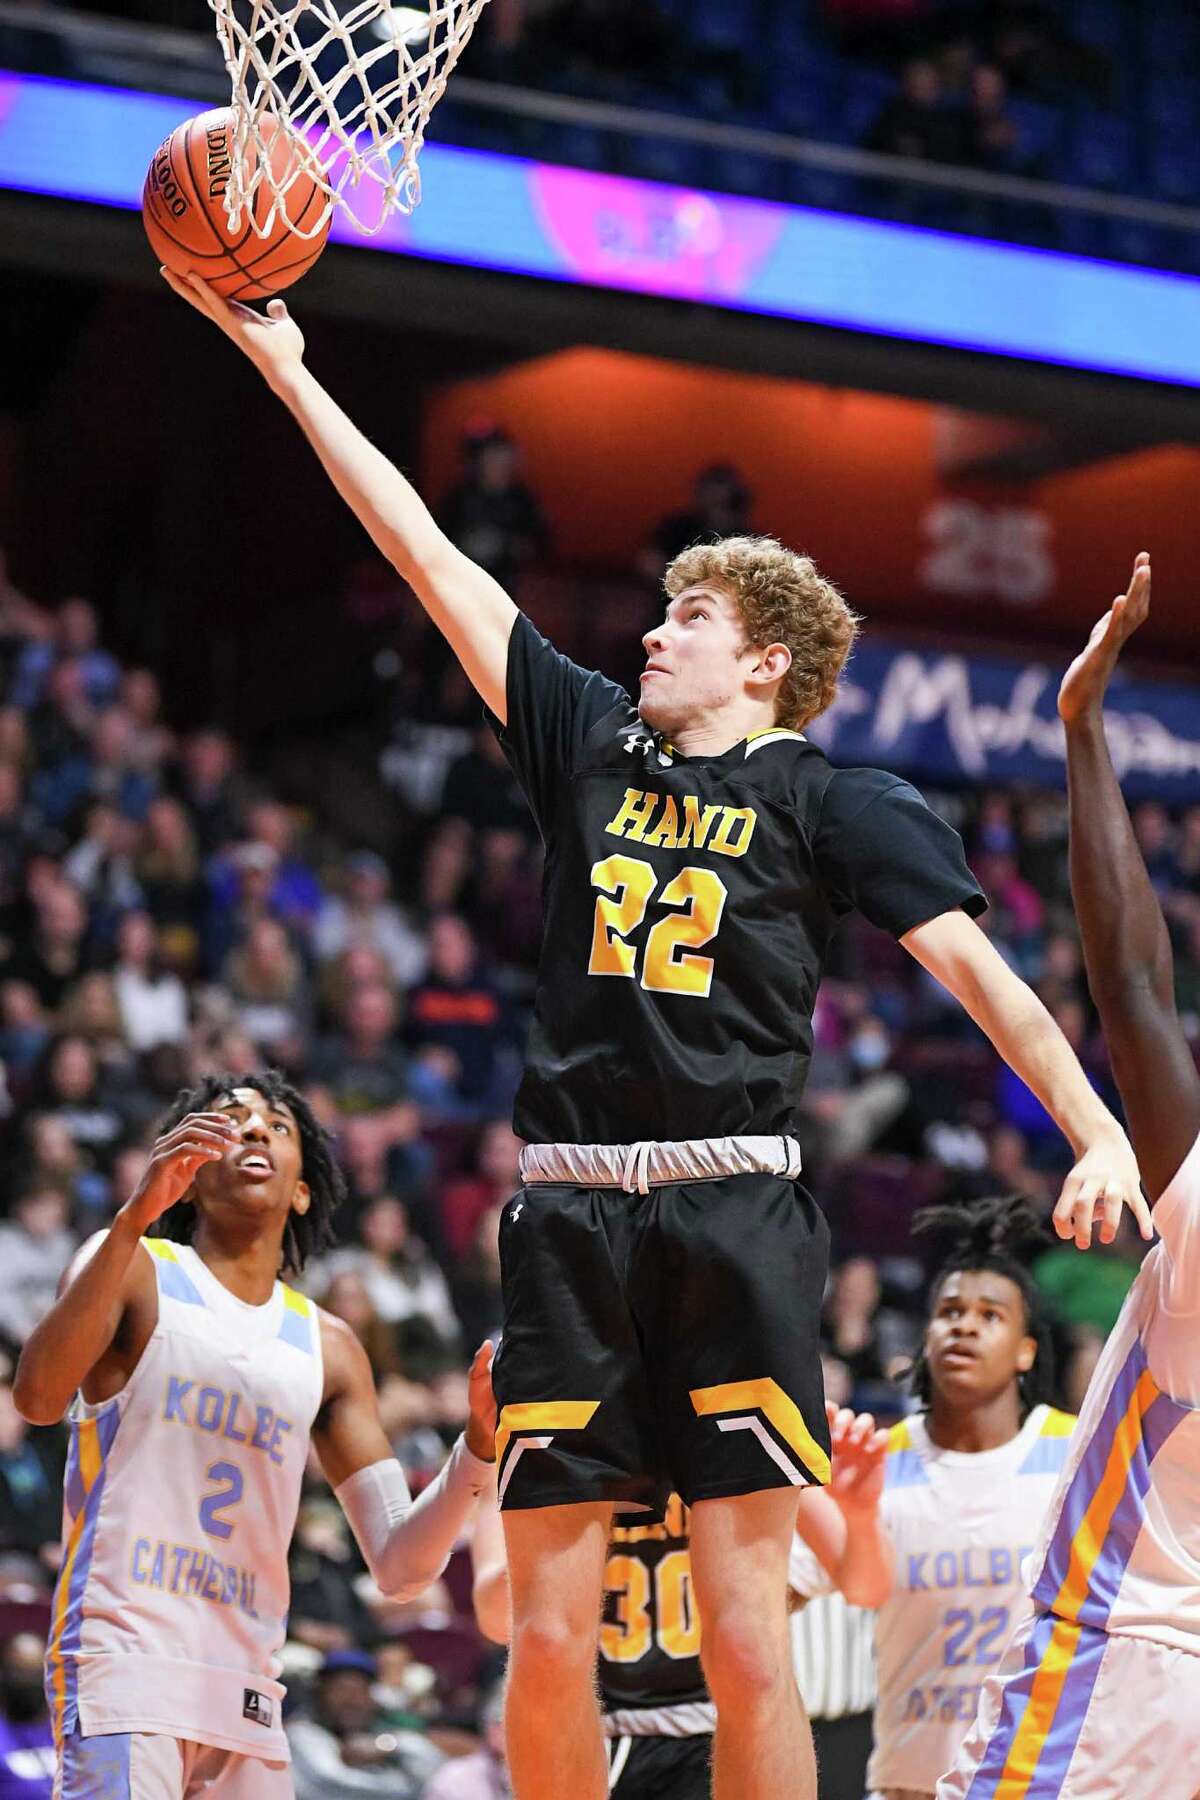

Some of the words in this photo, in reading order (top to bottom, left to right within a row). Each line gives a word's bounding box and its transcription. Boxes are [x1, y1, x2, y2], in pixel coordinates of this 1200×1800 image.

[604, 786, 758, 858] HAND
[586, 853, 728, 998] 22
[161, 1374, 292, 1466] KOLBE
[199, 1458, 246, 1542] 2
[599, 1551, 701, 1663] 30
[943, 1604, 1010, 1666] 22
